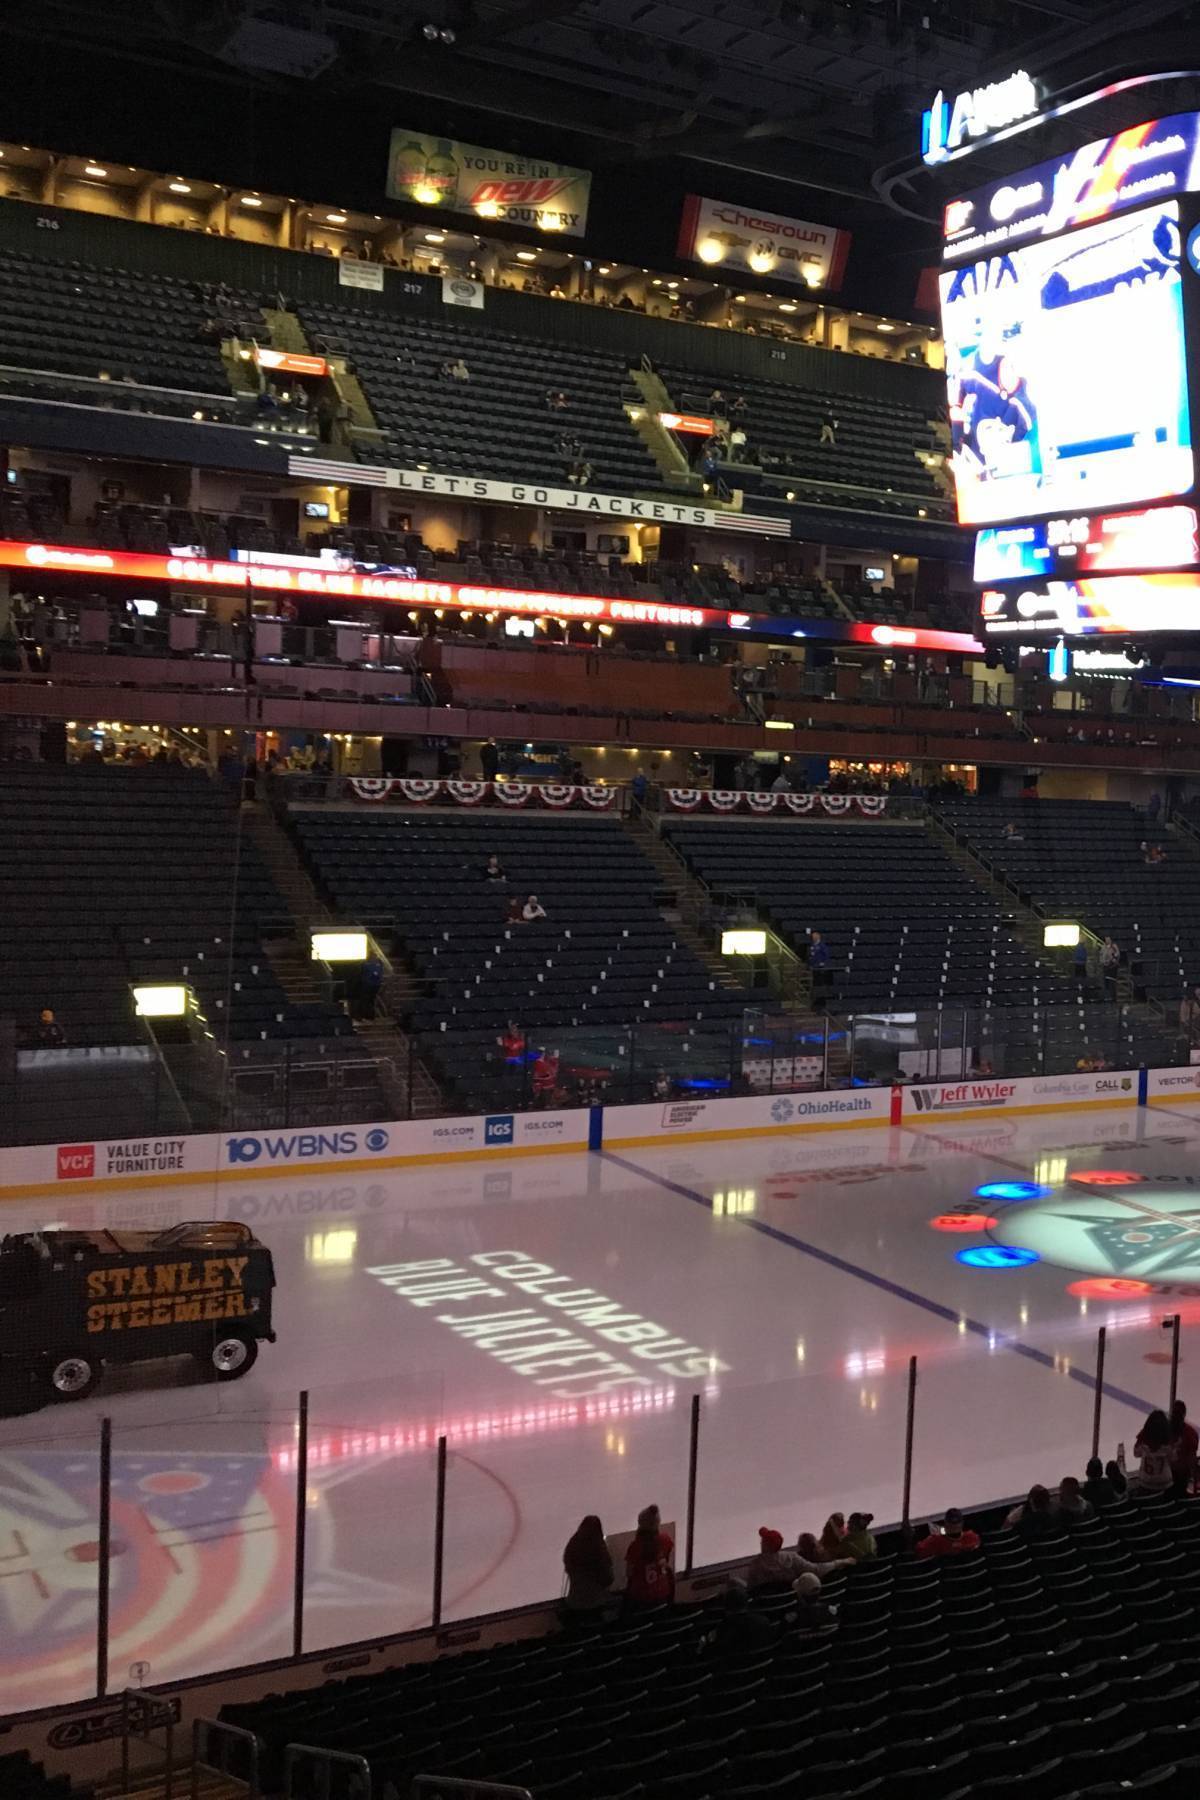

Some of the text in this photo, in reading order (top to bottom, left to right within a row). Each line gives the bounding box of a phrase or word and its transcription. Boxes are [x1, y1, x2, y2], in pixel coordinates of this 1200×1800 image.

[464, 157, 549, 179] YOU'RE IN
[36, 217, 60, 230] 216
[403, 283, 422, 295] 217
[399, 473, 706, 522] LET'S GO JACKETS
[167, 559, 291, 587] COLUMBUS
[298, 571, 354, 593] BLUE
[1096, 1079, 1119, 1090] CALL
[1158, 1076, 1193, 1086] VECTOR
[939, 1085, 970, 1102] Jeff
[972, 1083, 1016, 1104] Wyler
[797, 1097, 872, 1115] OhioHealth
[433, 1127, 474, 1137] IGS.COM
[488, 1123, 511, 1135] IGS
[524, 1120, 563, 1131] IGS.COM
[107, 1140, 186, 1159] VALUE CITY
[226, 1131, 357, 1162] 10 WBNS
[60, 1154, 92, 1170] VCF
[107, 1154, 185, 1174] FURNITURE
[87, 1257, 248, 1297] STANLEY
[366, 1257, 506, 1307] BLUE
[87, 1294, 247, 1333] STEEMER
[471, 1249, 730, 1379] COLUMBUS
[436, 1308, 660, 1400] JACKETS
